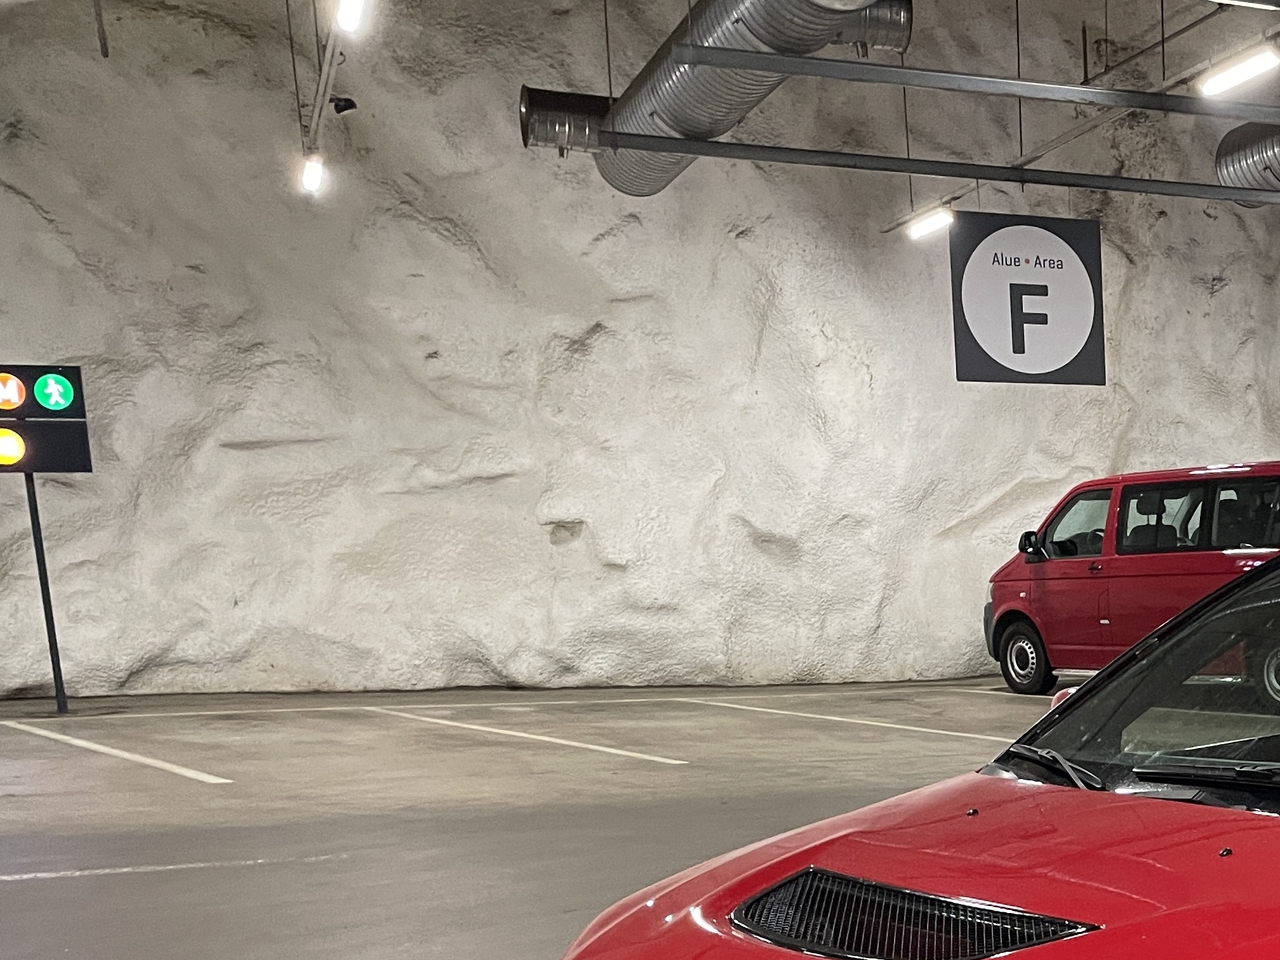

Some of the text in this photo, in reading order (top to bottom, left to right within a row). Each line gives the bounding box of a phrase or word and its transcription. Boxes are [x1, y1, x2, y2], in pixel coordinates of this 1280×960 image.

[991, 252, 1064, 269] Alue Area
[1009, 283, 1049, 355] F
